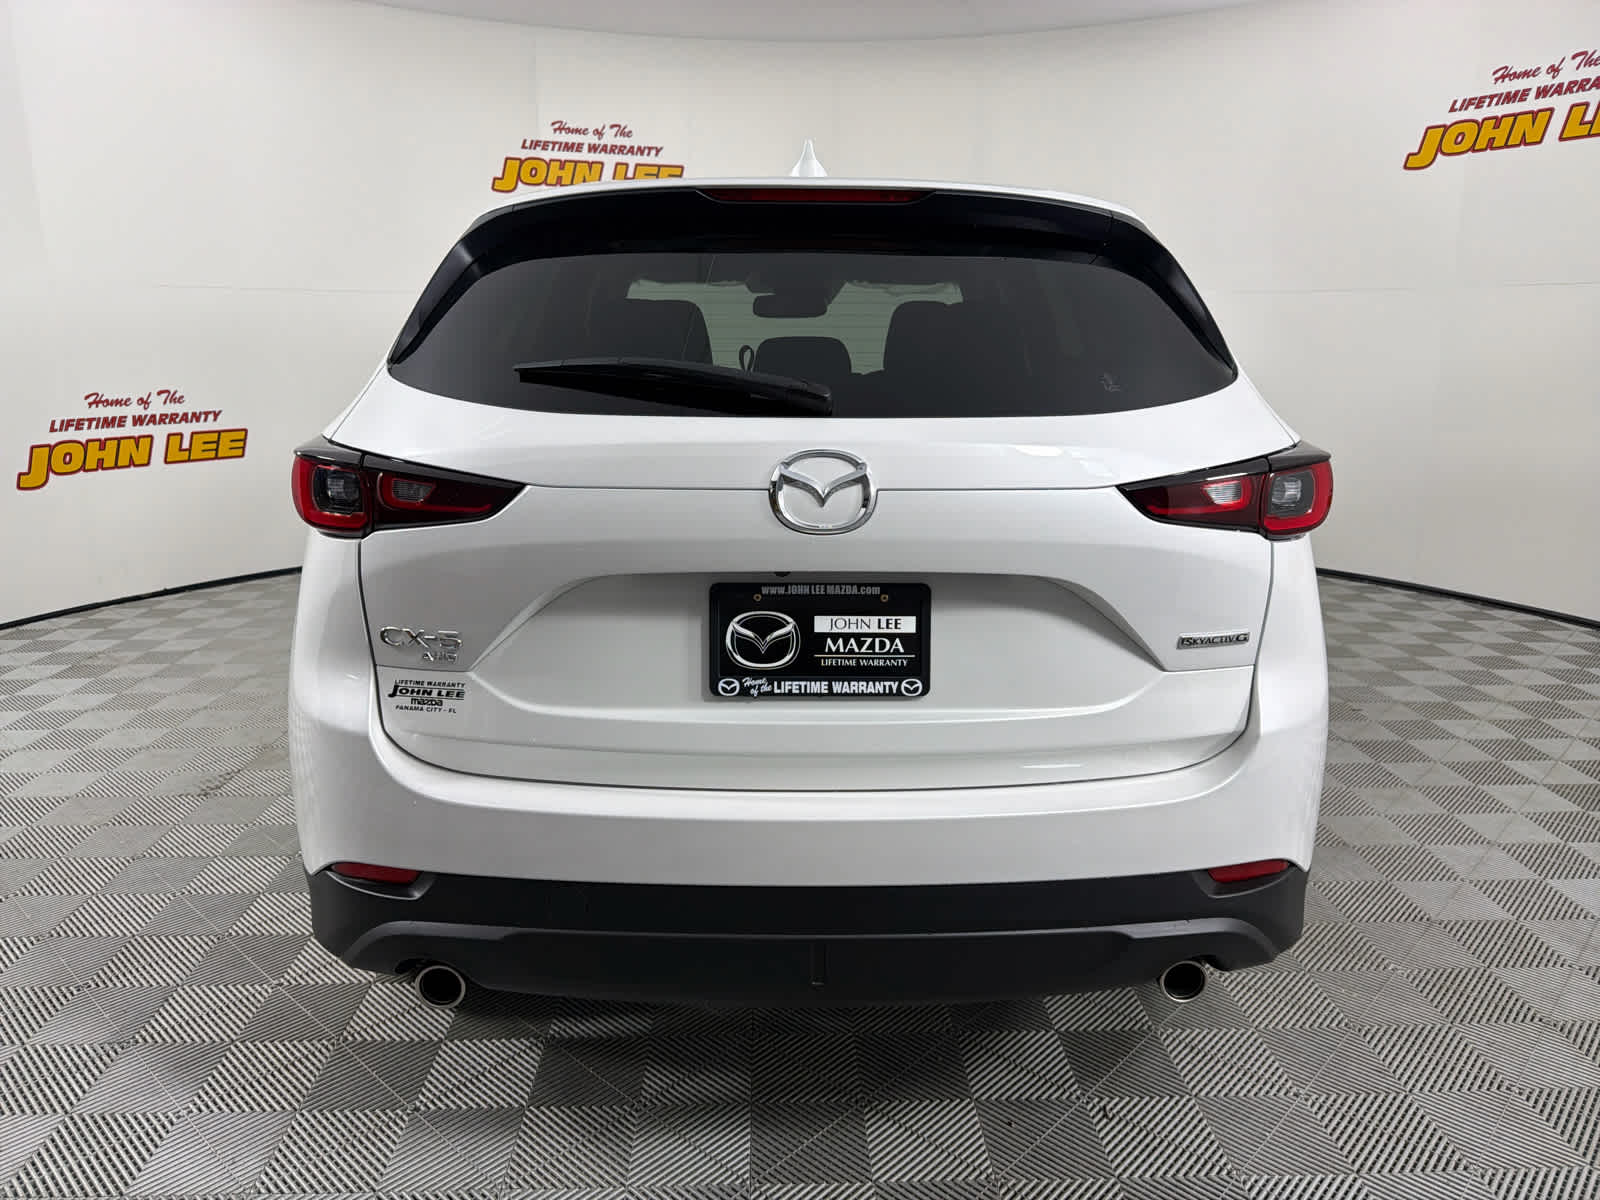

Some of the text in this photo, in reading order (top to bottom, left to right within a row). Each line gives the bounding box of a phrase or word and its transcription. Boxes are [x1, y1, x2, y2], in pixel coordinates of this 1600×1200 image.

[1492, 65, 1532, 84] Home
[1546, 56, 1566, 79] of
[1448, 88, 1532, 112] LIFETIME
[551, 120, 633, 140] Home of The
[1403, 106, 1555, 170] JOHN
[521, 139, 664, 157] LIFETIME WARRANTY
[491, 156, 605, 193] JOHN
[84, 389, 186, 409] Home of The
[49, 410, 223, 433] LIFETIME WARRANTY
[16, 428, 249, 491] JOHN LEE
[811, 584, 826, 595] LEE
[829, 617, 902, 630] JOHN LEE
[824, 637, 905, 653] MAZDA
[820, 658, 908, 667] LIFETIME WARRANTY
[394, 679, 466, 688] LIFETIME WARRANTY
[742, 677, 768, 687] Home
[750, 680, 899, 697] of the LIFETIME WARRANTY
[387, 684, 466, 698] JOHN LEE
[395, 704, 424, 712] PANAMA
